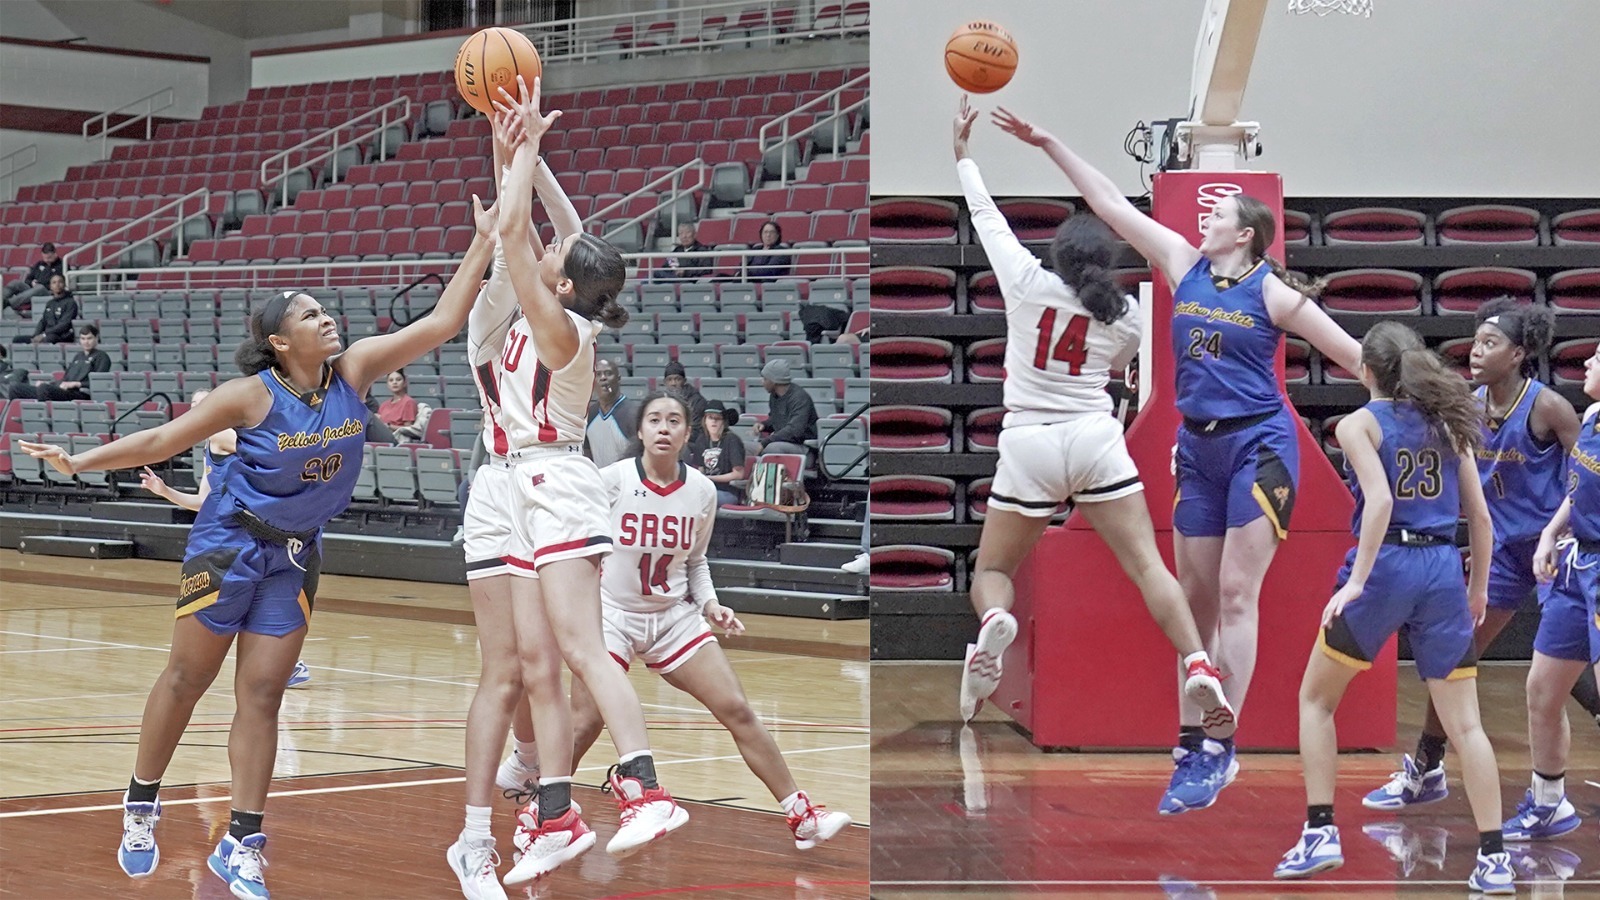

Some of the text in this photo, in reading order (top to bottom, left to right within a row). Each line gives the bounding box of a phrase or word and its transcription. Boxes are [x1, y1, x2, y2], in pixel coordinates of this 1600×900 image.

[1207, 307, 1254, 328] Jackets
[1033, 306, 1091, 376] 14
[1189, 327, 1222, 361] 24
[277, 418, 363, 452] Yellow Jackets
[301, 452, 342, 482] 20
[1395, 447, 1442, 500] 23
[1491, 471, 1505, 499] 1
[619, 512, 695, 550] SRSU
[638, 552, 675, 596] 14
